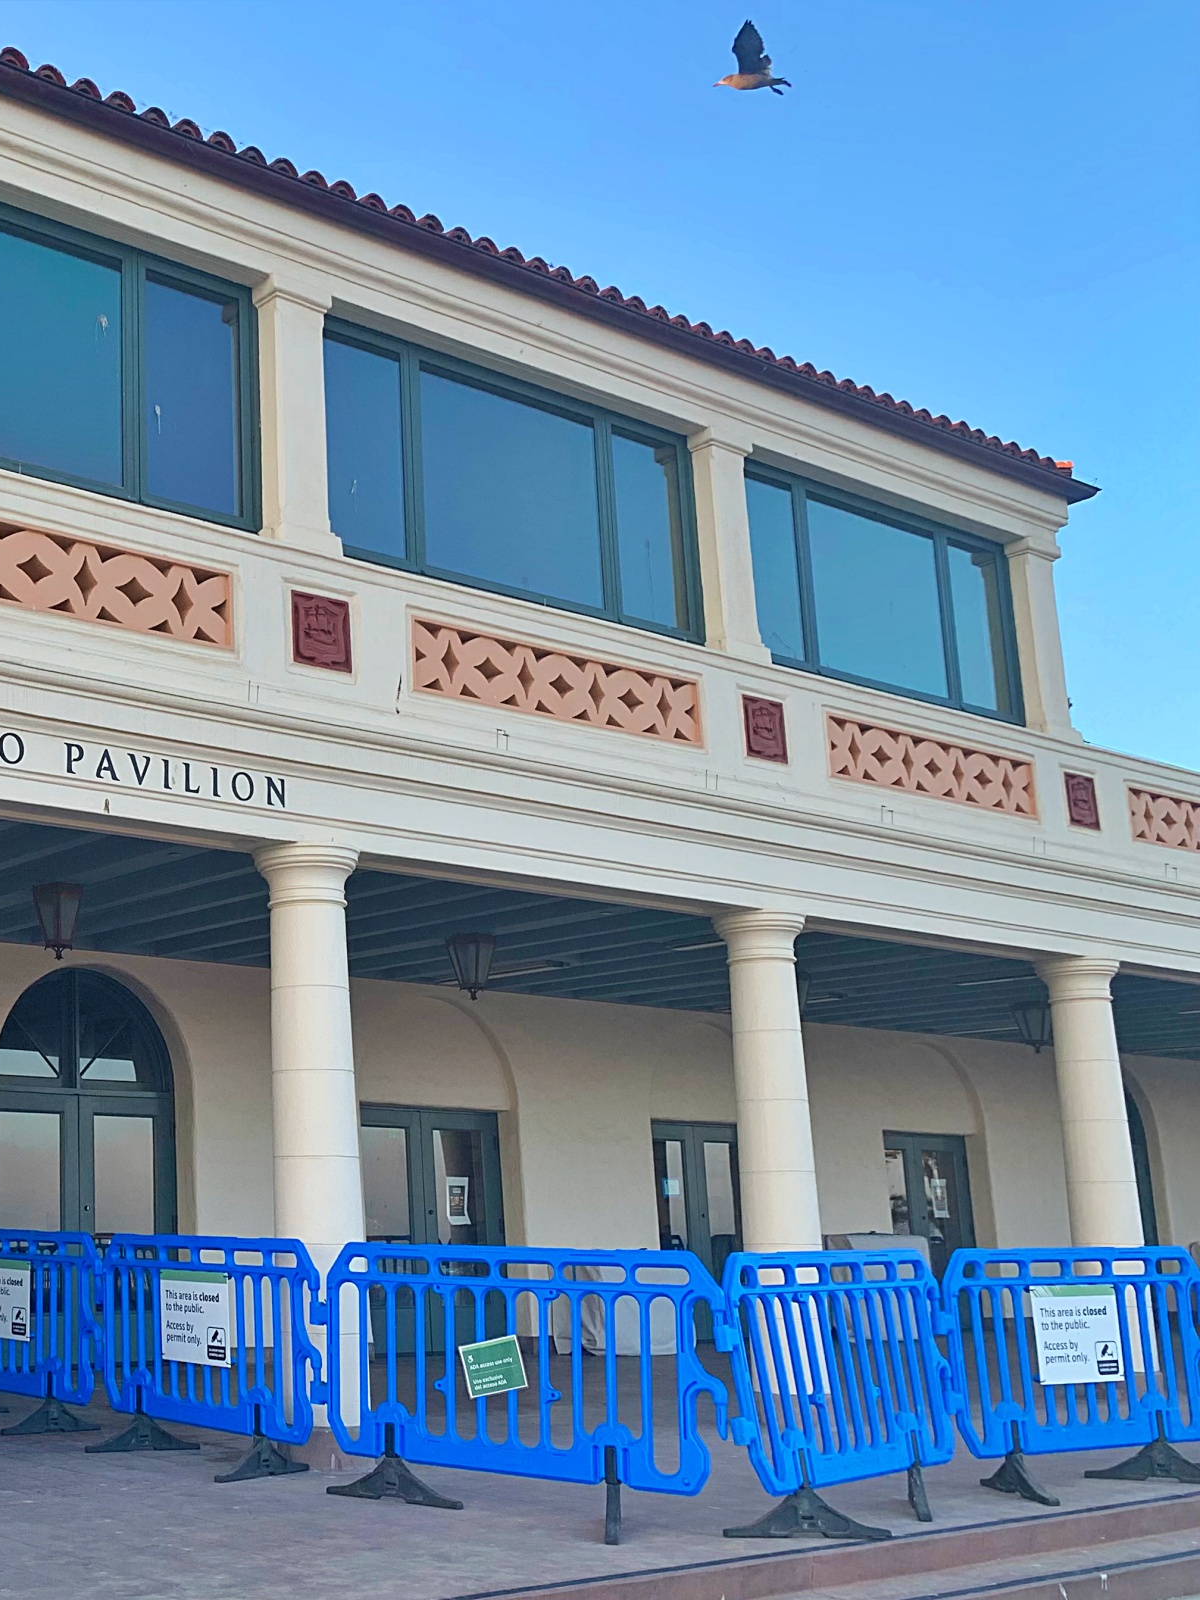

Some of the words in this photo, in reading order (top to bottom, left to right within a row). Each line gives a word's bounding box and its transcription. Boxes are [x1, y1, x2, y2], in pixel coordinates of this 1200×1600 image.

[63, 742, 287, 809] PAVILION
[2, 1276, 6, 1285] is
[7, 1277, 23, 1286] closed
[165, 1290, 177, 1299] This
[179, 1292, 191, 1300] area
[193, 1291, 198, 1301] is
[199, 1292, 220, 1302] closed
[166, 1302, 173, 1311] to
[173, 1302, 183, 1312] the
[184, 1303, 205, 1314] public.
[1040, 1307, 1056, 1317] This
[1057, 1309, 1073, 1317] area
[1075, 1306, 1081, 1316] is
[1082, 1305, 1107, 1316] closed
[166, 1320, 185, 1331] Access
[186, 1321, 194, 1333] by
[1041, 1321, 1049, 1330] to
[1051, 1320, 1063, 1330] the
[1065, 1319, 1090, 1332] public.
[166, 1333, 186, 1343] permit
[187, 1334, 202, 1346] only.
[1044, 1341, 1068, 1351] Access
[1069, 1340, 1078, 1352] by
[1045, 1353, 1070, 1366] permit
[1072, 1352, 1090, 1364] only.
